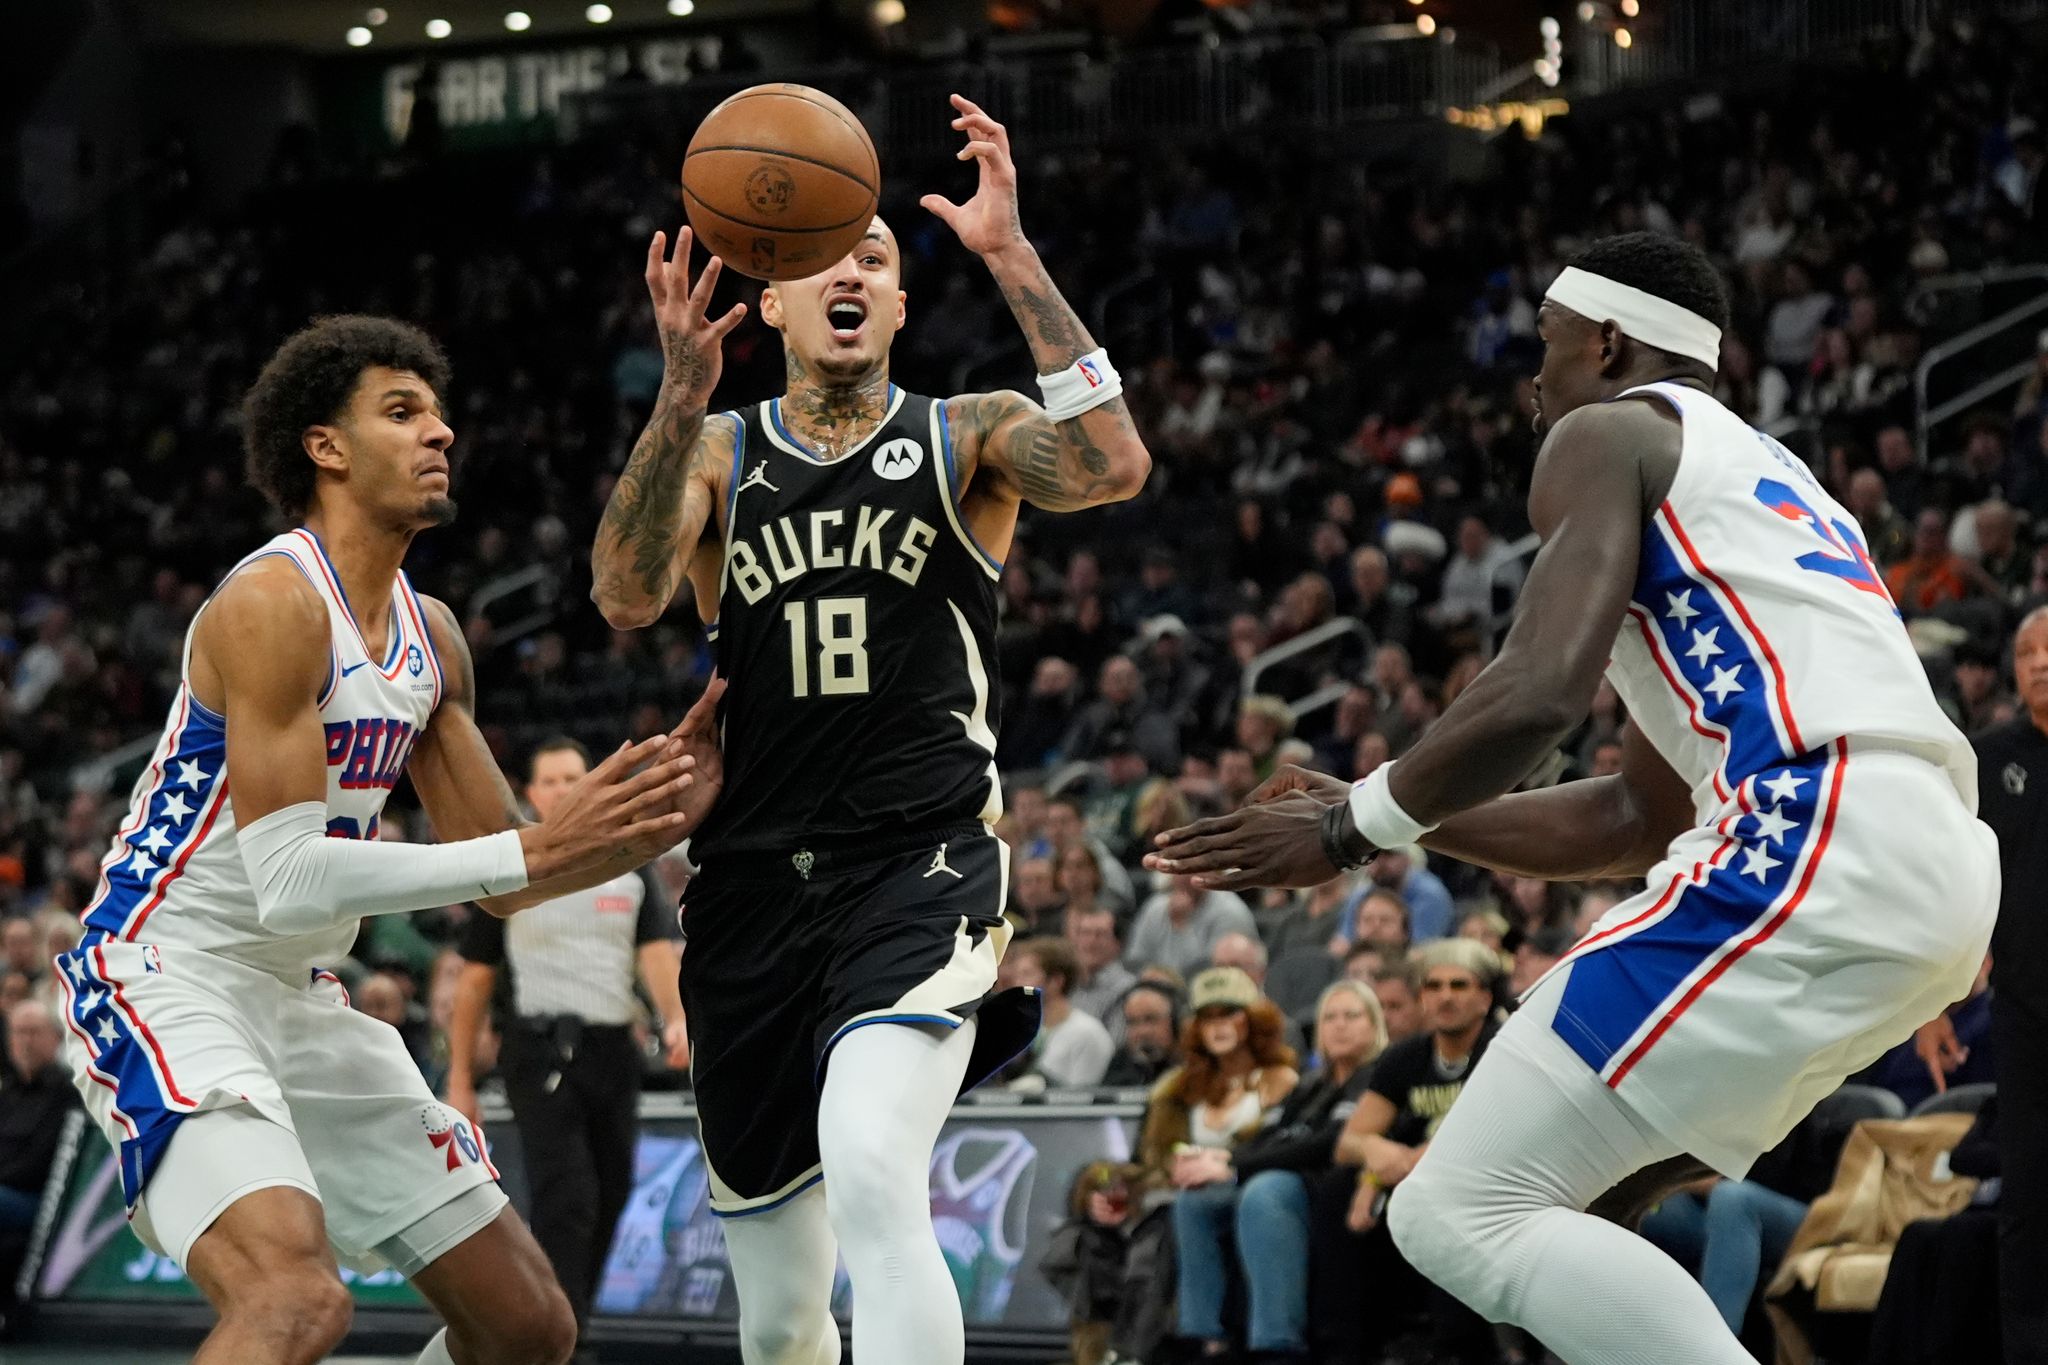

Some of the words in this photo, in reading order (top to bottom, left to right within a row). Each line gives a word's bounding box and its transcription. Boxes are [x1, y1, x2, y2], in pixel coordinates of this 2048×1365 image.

[384, 58, 507, 143] FAR
[731, 504, 938, 606] BUCKS
[784, 596, 870, 698] 18
[427, 1121, 480, 1174] 76
